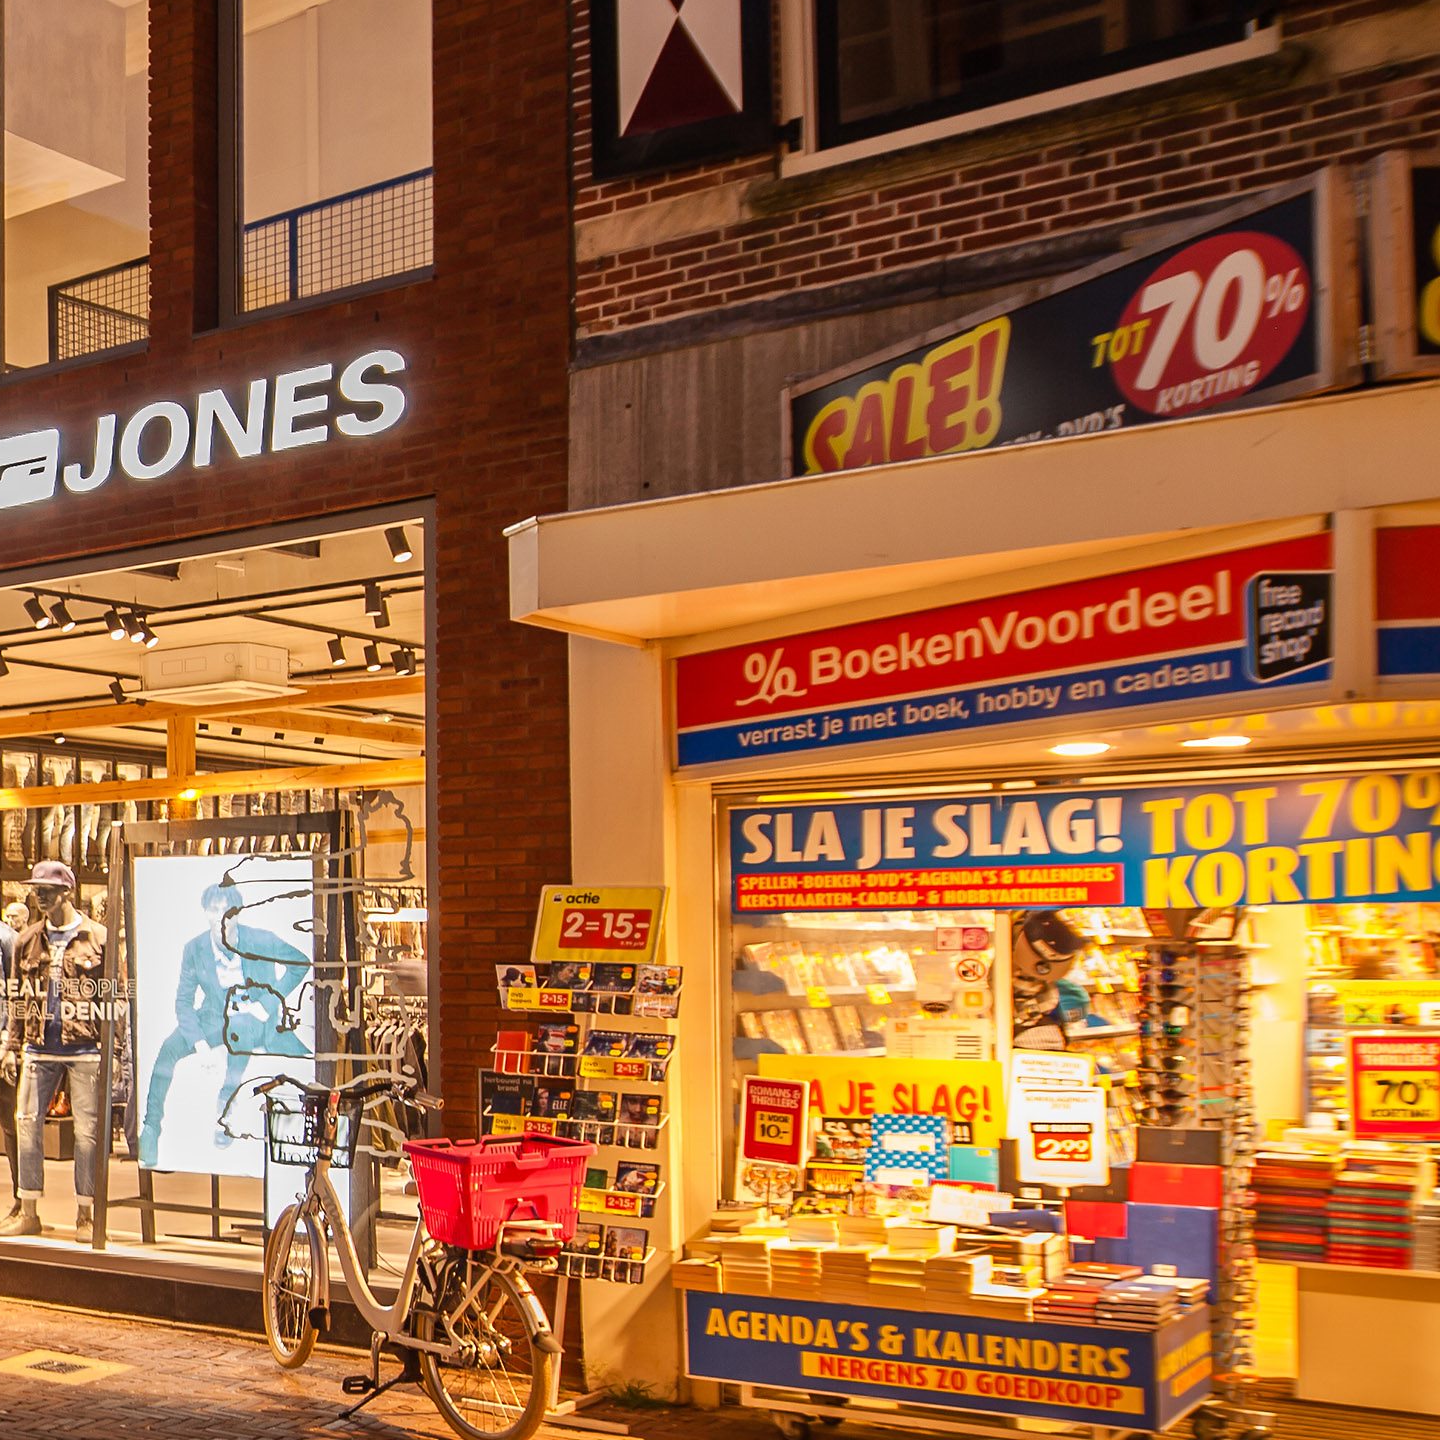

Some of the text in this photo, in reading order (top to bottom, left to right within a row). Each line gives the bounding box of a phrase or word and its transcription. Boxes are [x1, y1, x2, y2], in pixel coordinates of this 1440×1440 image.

[1091, 318, 1151, 368] TOT
[1135, 249, 1305, 391] 70%
[806, 320, 1008, 473] SALE!
[1154, 360, 1261, 416] KORTING
[62, 348, 408, 493] JONES
[1258, 578, 1303, 609] free
[1259, 599, 1325, 636] record
[809, 569, 1233, 686] BoekenVoordeel
[1260, 634, 1313, 664] shop
[737, 659, 1232, 748] verrast je met boek, hobby en cadeau
[741, 796, 1124, 870] SLA JE SLAG!
[1141, 786, 1279, 855] TOT
[927, 889, 940, 905] &
[945, 886, 1089, 905] HOBBYARTIKELEN
[1000, 869, 1013, 884] &
[1019, 865, 1116, 884] KALENDERS
[1142, 831, 1440, 910] KORTIN
[565, 892, 600, 905] actie
[0, 999, 131, 1021] REAL DENIM
[52, 978, 136, 999] PEOPLE
[749, 1085, 791, 1098] ROMANS
[751, 1094, 799, 1109] THRILLERS
[839, 1079, 876, 1116] JE
[892, 1083, 993, 1123] SLAG!
[704, 1307, 869, 1352] AGENDA'S
[877, 1324, 905, 1355] &
[913, 1327, 1131, 1380] KALENDERS
[818, 1354, 1125, 1410] NERGENS ZO GOEDKOOP
